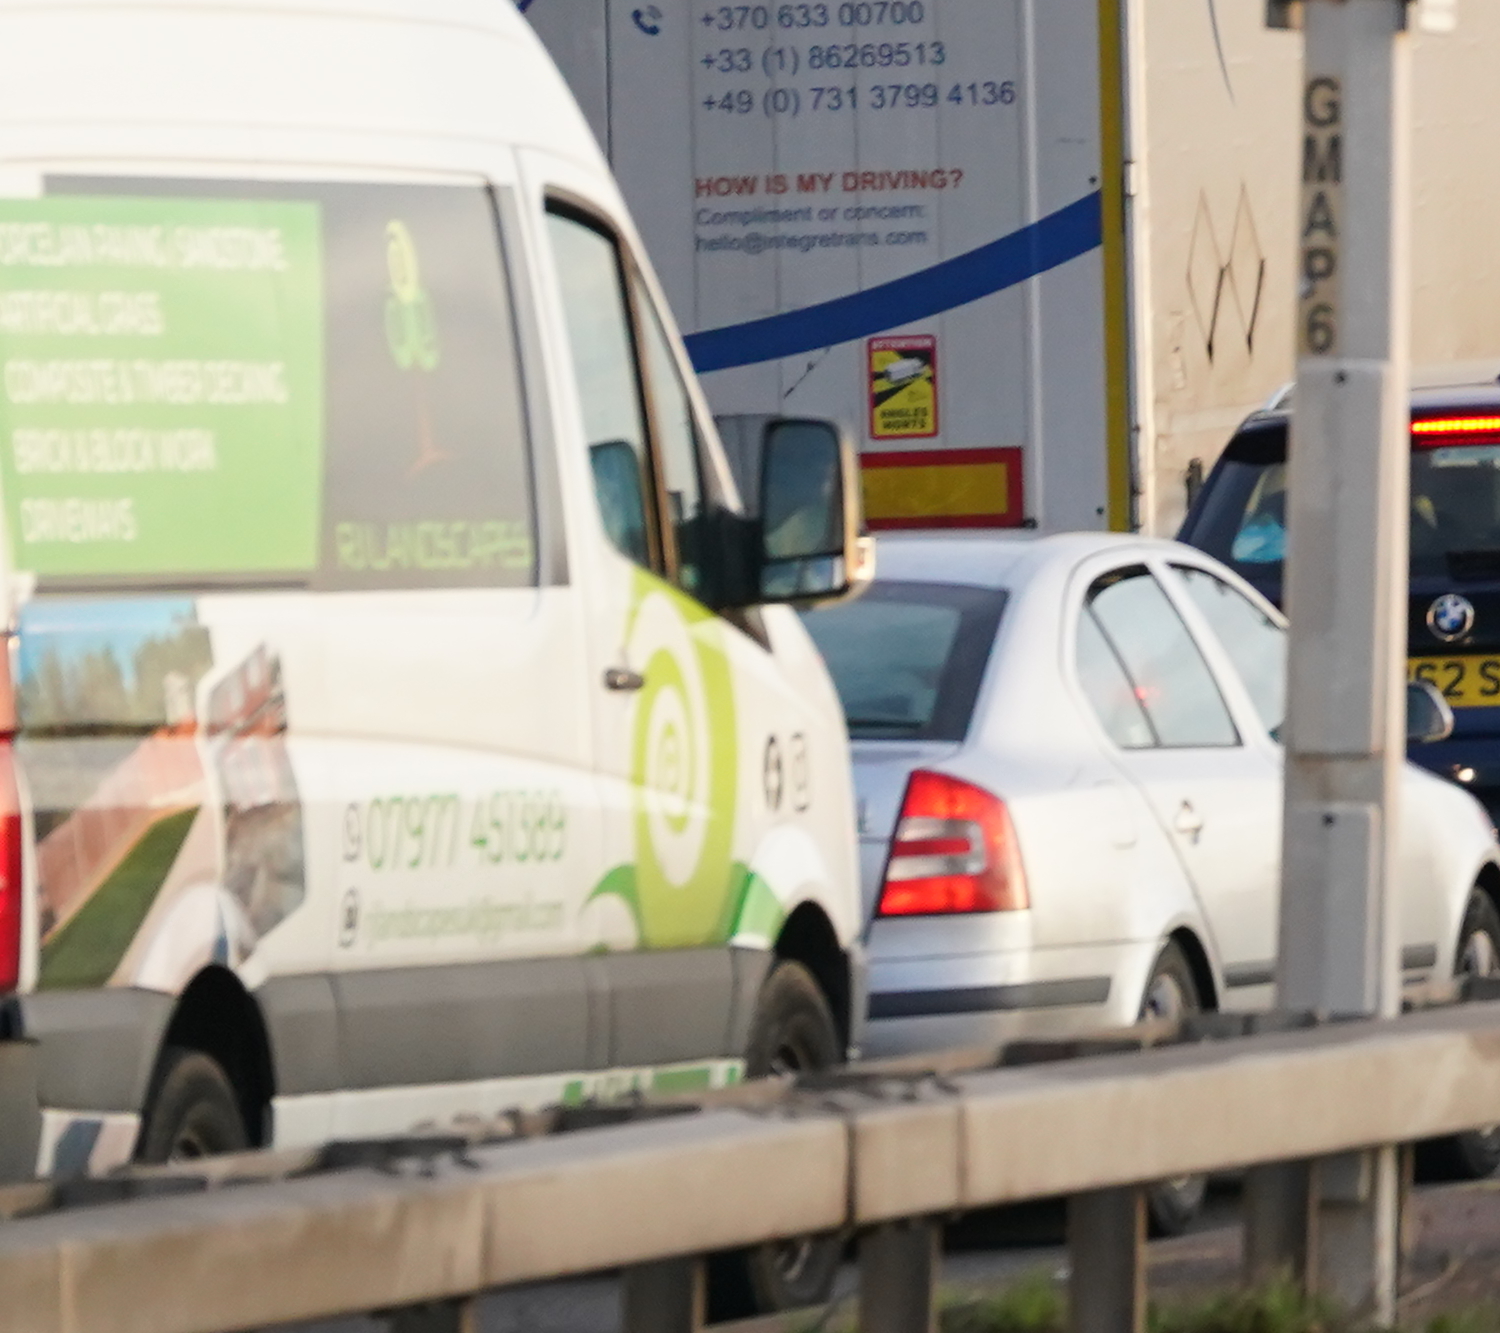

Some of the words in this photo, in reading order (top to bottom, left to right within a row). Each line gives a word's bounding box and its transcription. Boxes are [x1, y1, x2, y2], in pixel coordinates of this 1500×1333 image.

[702, 5, 768, 30] +370
[778, 4, 829, 28] 633
[838, 0, 924, 26] 00700
[701, 48, 752, 72] +33
[762, 46, 799, 76] (1)
[808, 41, 946, 69] 86269513
[702, 90, 753, 115] +49
[763, 88, 799, 118] (0)
[810, 85, 858, 111] 731
[870, 83, 938, 109] 3799
[946, 81, 1016, 107] 4136
[695, 175, 756, 198] HOW
[765, 173, 790, 194] IS
[796, 172, 833, 192] MY
[842, 168, 964, 191] DRIVING?
[817, 208, 840, 222] or
